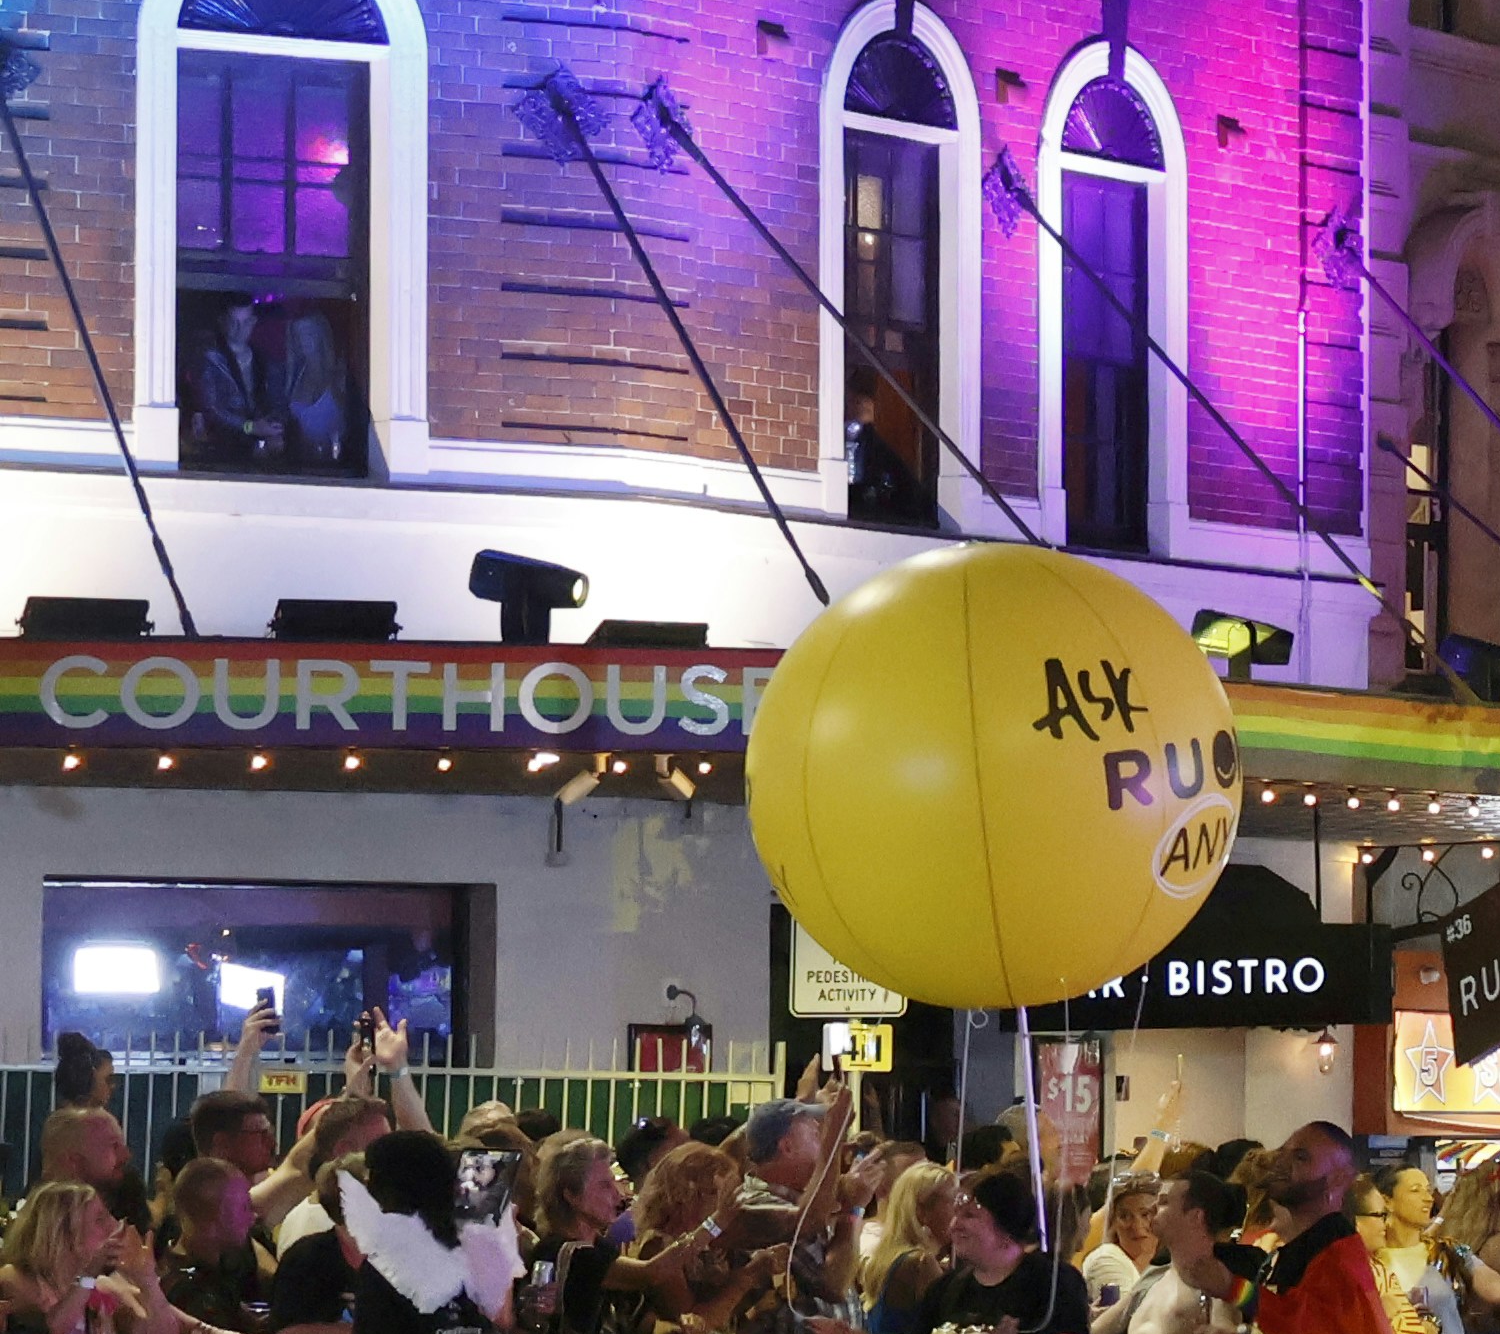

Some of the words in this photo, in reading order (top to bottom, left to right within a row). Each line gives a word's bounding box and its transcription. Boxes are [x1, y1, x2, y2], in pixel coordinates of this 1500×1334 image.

[1032, 657, 1148, 742] Ask
[818, 988, 877, 1002] ACTIVITY
[1167, 958, 1325, 996] BISTRO
[1418, 1047, 1439, 1087] 5
[1047, 1075, 1093, 1113] $15
